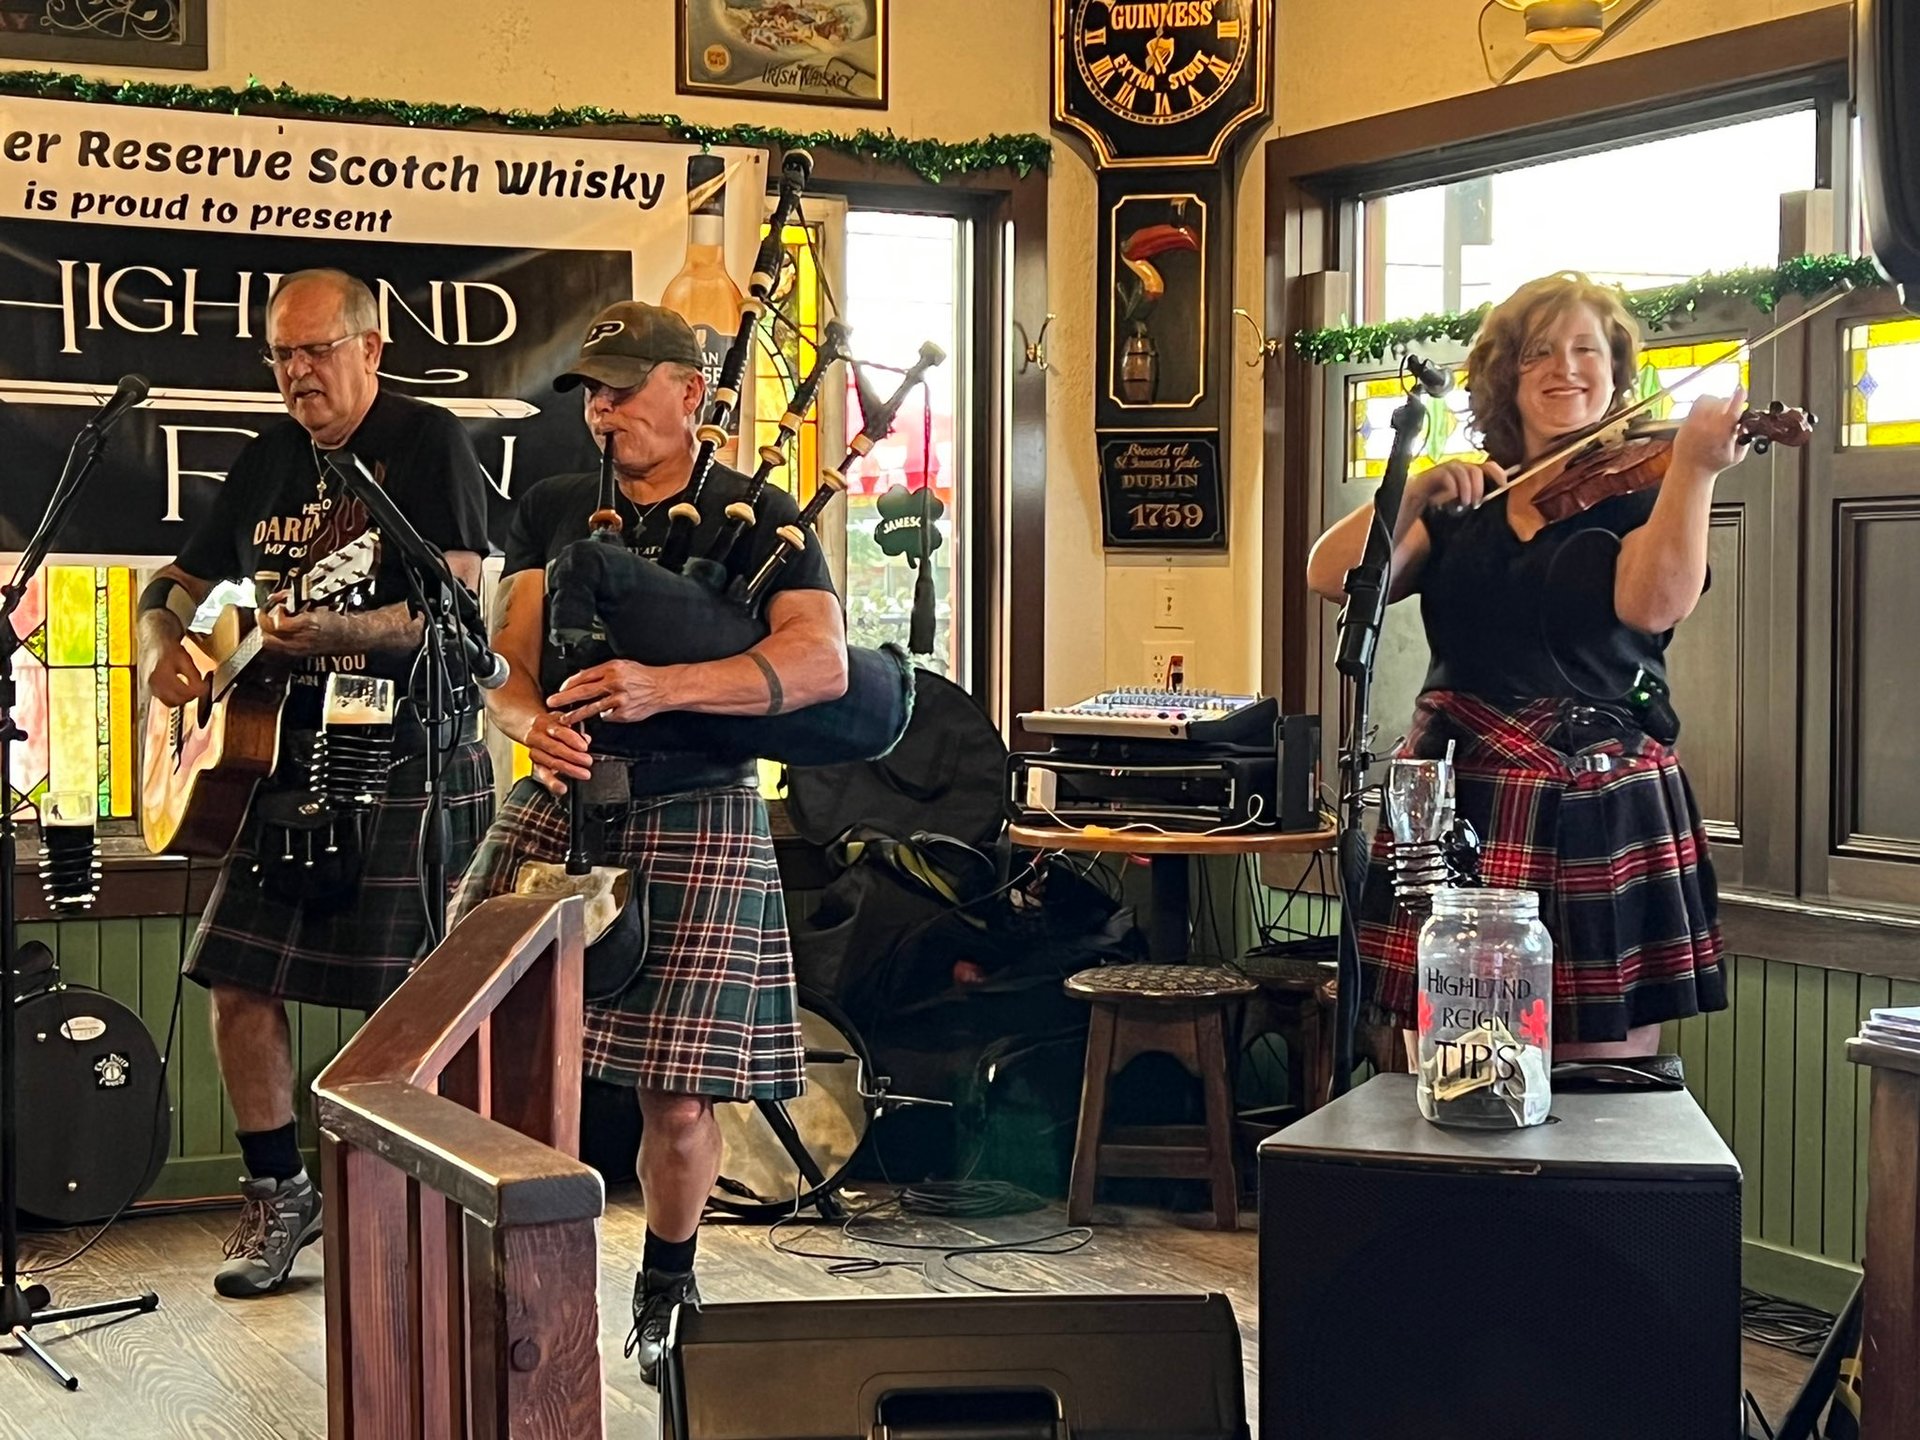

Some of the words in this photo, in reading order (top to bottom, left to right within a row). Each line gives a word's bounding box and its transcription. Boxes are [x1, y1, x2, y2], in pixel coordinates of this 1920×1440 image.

[1111, 1, 1213, 30] GUINNESS
[762, 62, 798, 87] IRISH
[1113, 53, 1155, 92] EXTRA
[1168, 50, 1210, 90] STOUT
[3, 130, 61, 163] er
[78, 130, 292, 181] Reserve
[308, 148, 479, 193] Scotch
[495, 158, 665, 210] Whisky
[24, 180, 58, 211] is
[71, 192, 189, 220] proud
[202, 198, 238, 224] to
[250, 202, 392, 232] present
[582, 320, 626, 349] P
[1172, 443, 1189, 456] at
[1121, 473, 1198, 489] DUBLIN
[883, 516, 921, 534] JAMES
[1128, 503, 1204, 528] 1759
[264, 543, 287, 555] MY
[331, 654, 366, 672] YOU
[1426, 966, 1531, 999] HIGHLAND
[1443, 1006, 1510, 1031] REIGN
[1435, 1039, 1517, 1081] TIPS
